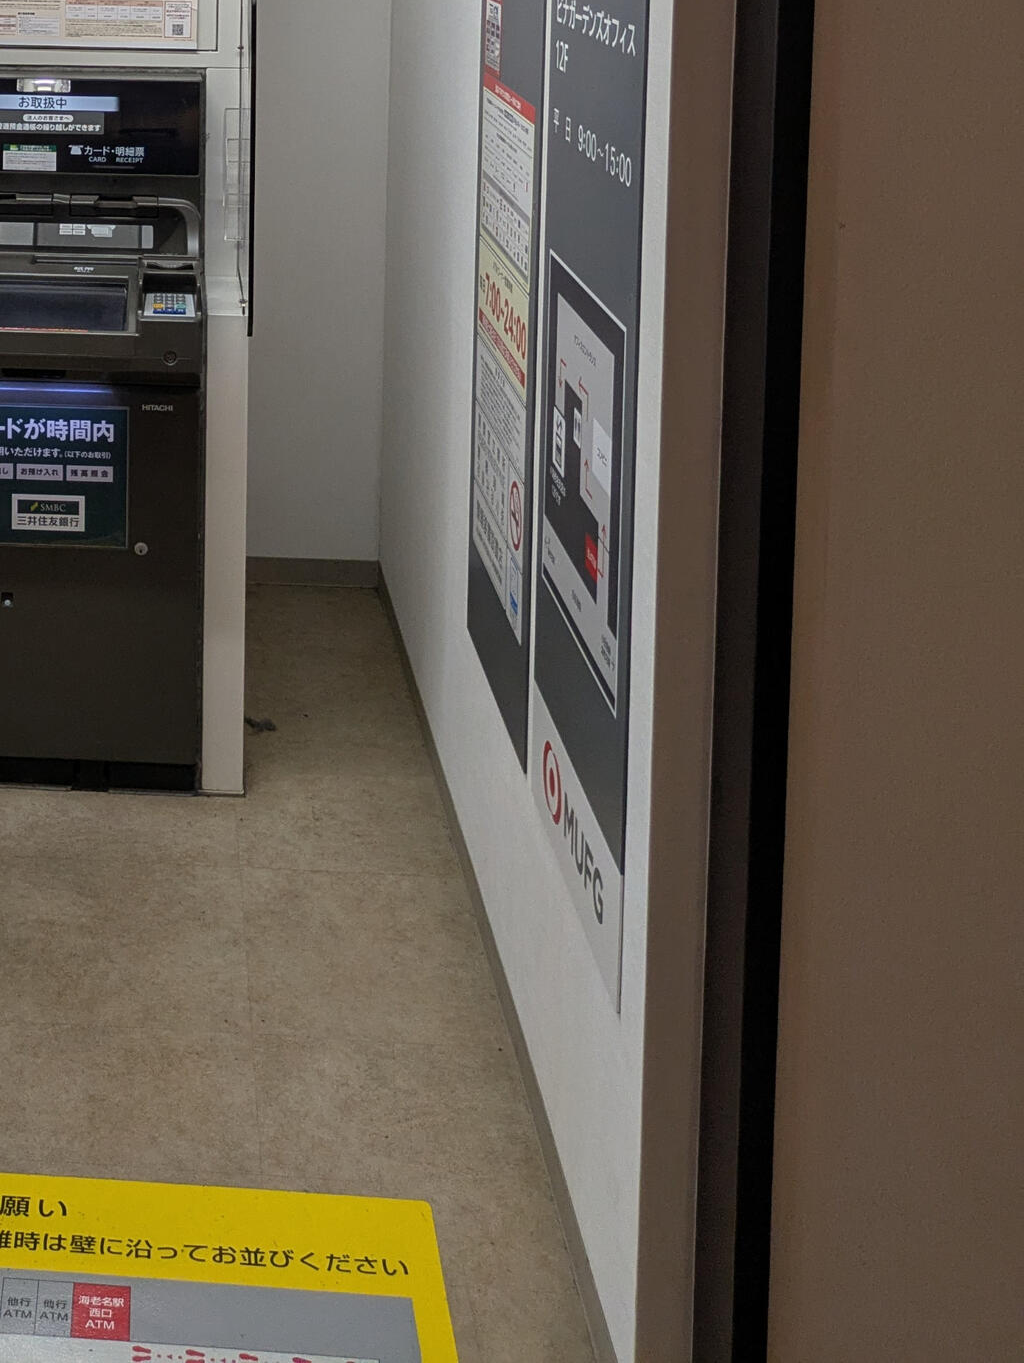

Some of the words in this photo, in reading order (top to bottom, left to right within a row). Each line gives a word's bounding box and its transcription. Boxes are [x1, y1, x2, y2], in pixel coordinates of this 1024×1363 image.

[555, 39, 569, 73] 12F
[18, 96, 67, 109] お取扱中
[141, 404, 174, 412] HITACHI
[20, 467, 59, 477] お預け入れ
[40, 503, 67, 512] SMBC
[17, 516, 79, 528] 三井住友銀行
[563, 791, 603, 925] MUFG
[7, 1296, 32, 1307] 他行
[43, 1298, 68, 1309] 他行
[78, 1295, 125, 1308] 海老名駅
[3, 1309, 32, 1319] ATM
[40, 1312, 69, 1322] ATM
[89, 1308, 113, 1318] 西口
[85, 1320, 115, 1330] ATM
